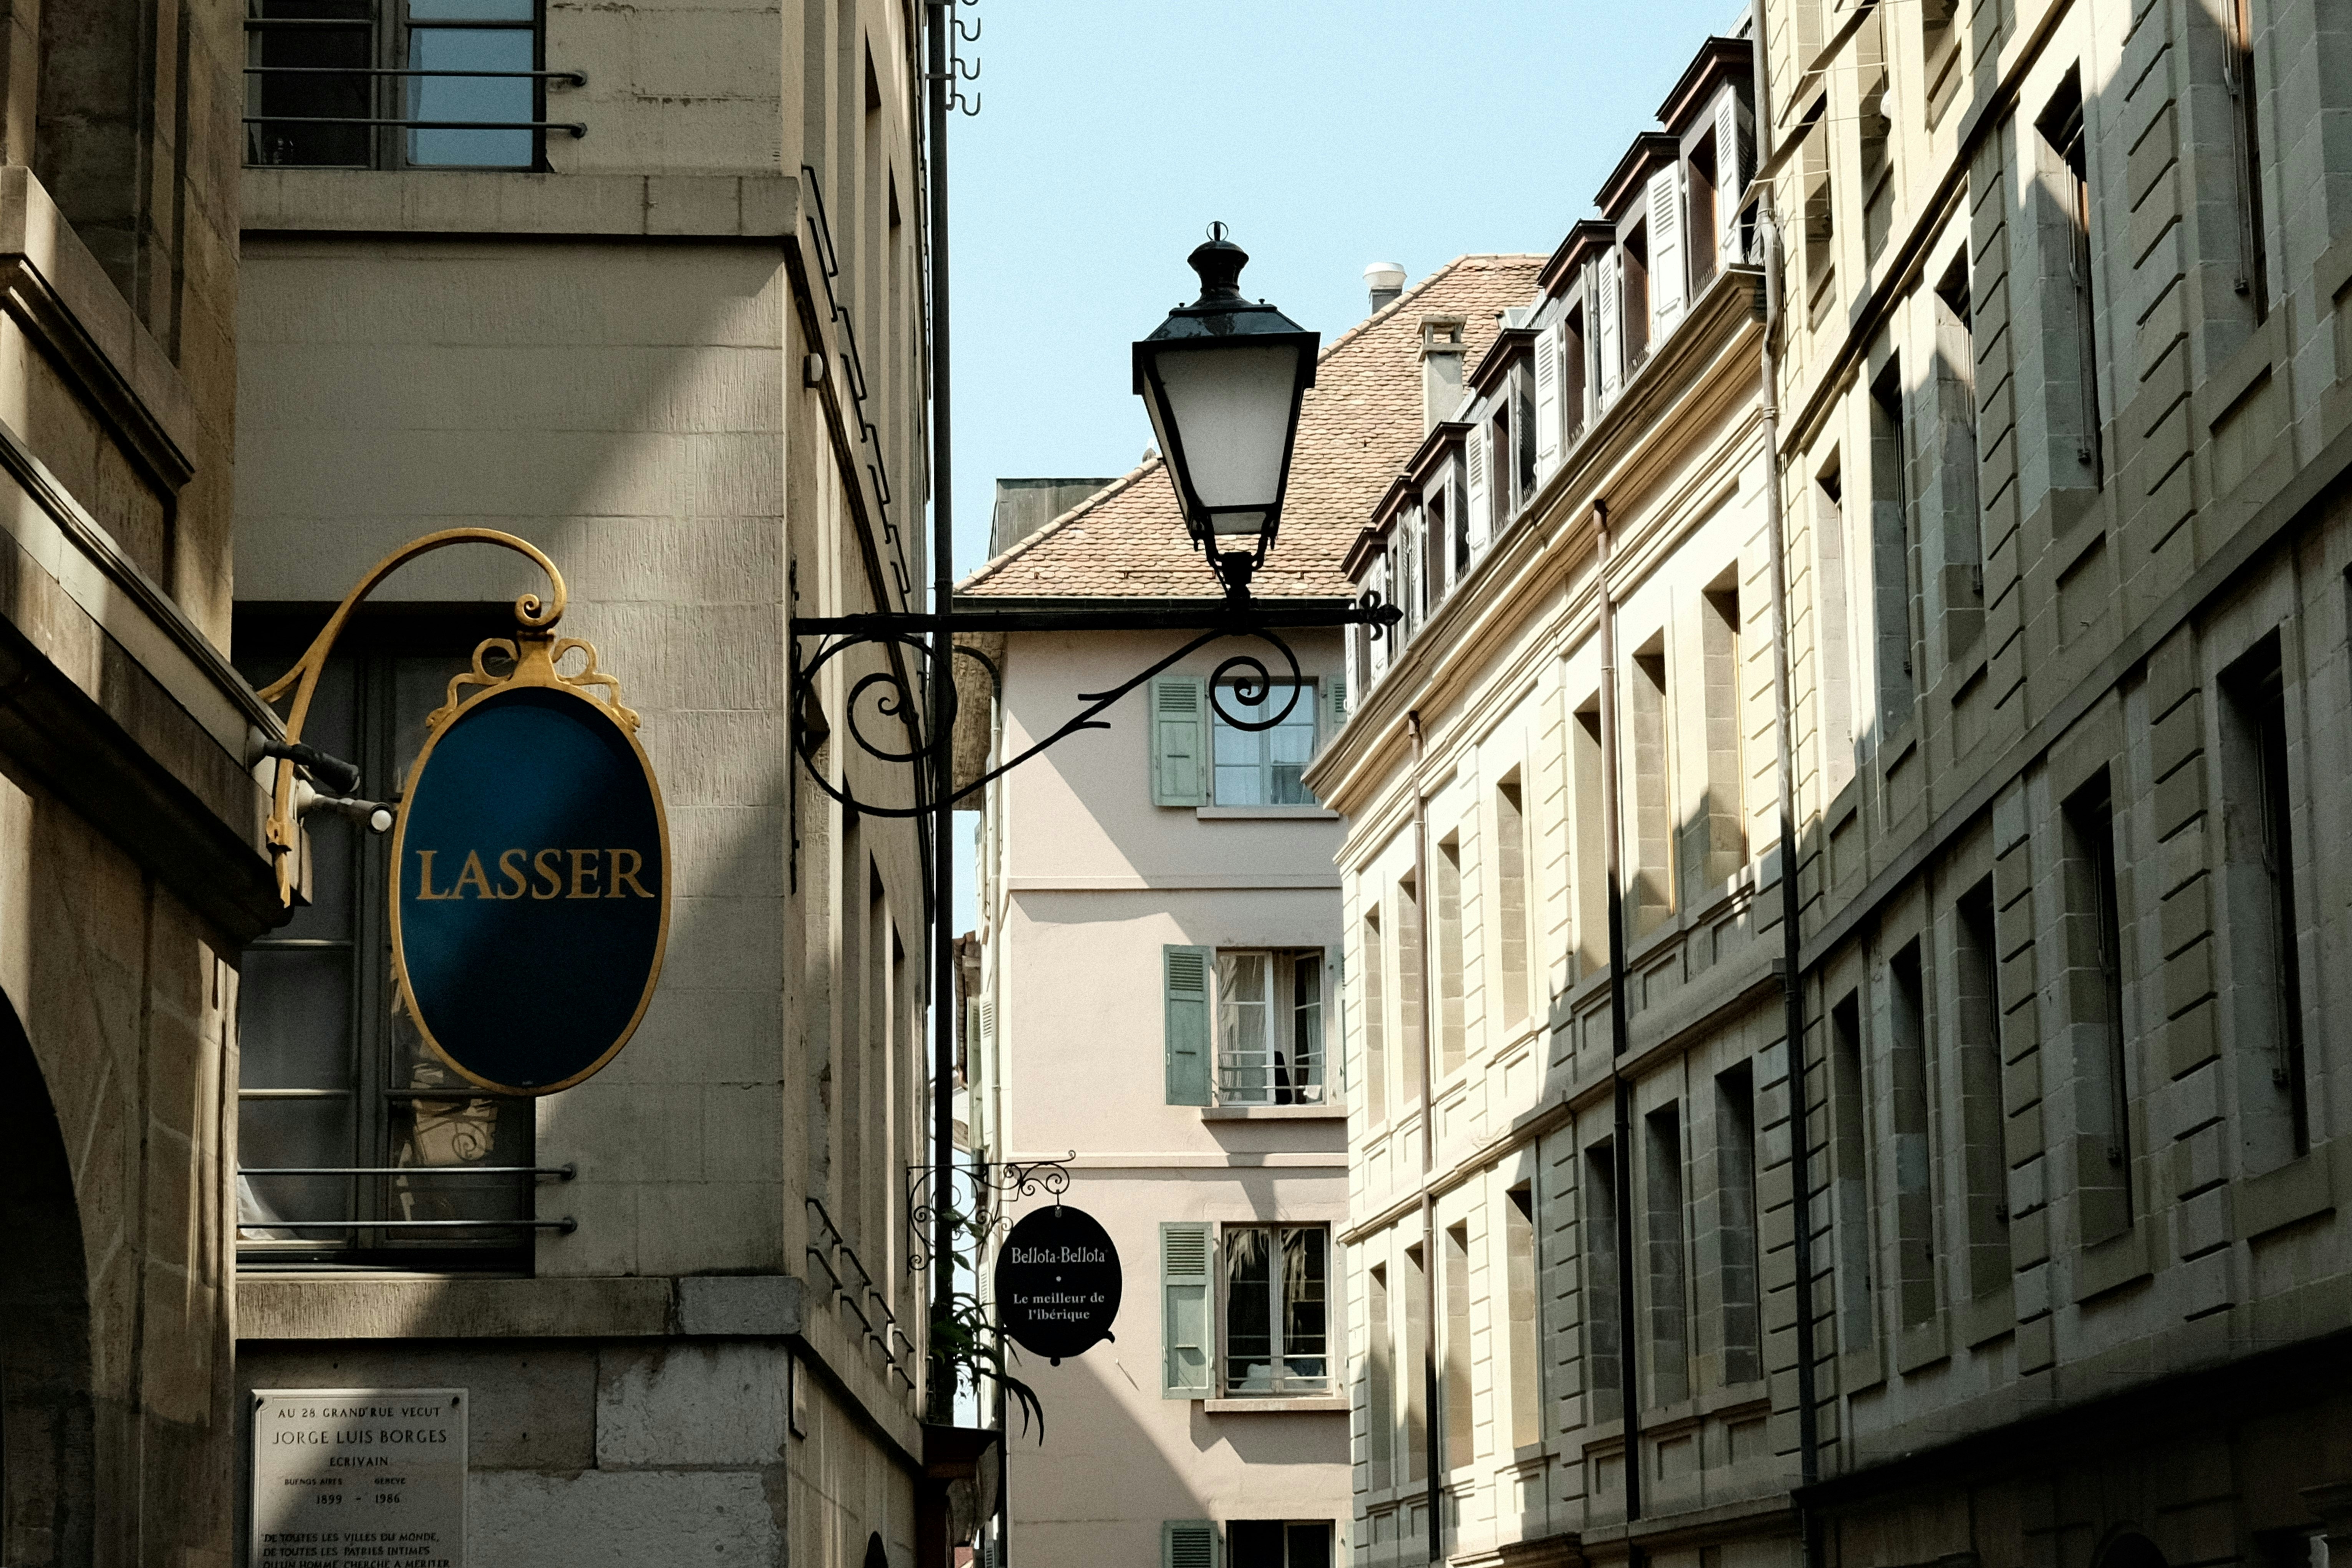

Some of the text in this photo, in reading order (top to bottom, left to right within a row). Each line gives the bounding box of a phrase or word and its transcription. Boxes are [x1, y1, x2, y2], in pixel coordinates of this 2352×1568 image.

[416, 848, 655, 900] LASSER
[1012, 1246, 1105, 1264] Bellota-Bellota
[1014, 1292, 1105, 1304] Le meilleur de
[1028, 1308, 1090, 1322] l'ibérique
[278, 1409, 295, 1418] AU
[301, 1408, 315, 1417] 28
[402, 1407, 440, 1417] VECUT
[273, 1429, 447, 1444] JORGE LUIS BORGES
[330, 1457, 388, 1467] ECRIVAIN
[316, 1495, 342, 1505] 1899
[375, 1494, 400, 1503] 1986
[264, 1534, 277, 1542] DE
[279, 1533, 318, 1542] TOUTES
[322, 1533, 339, 1542] LES
[345, 1533, 376, 1542] VILLES
[381, 1533, 395, 1542] DU
[263, 1546, 430, 1556] DE TOUTES LES PATRIES INTIMES
[300, 1559, 339, 1568] HOMME
